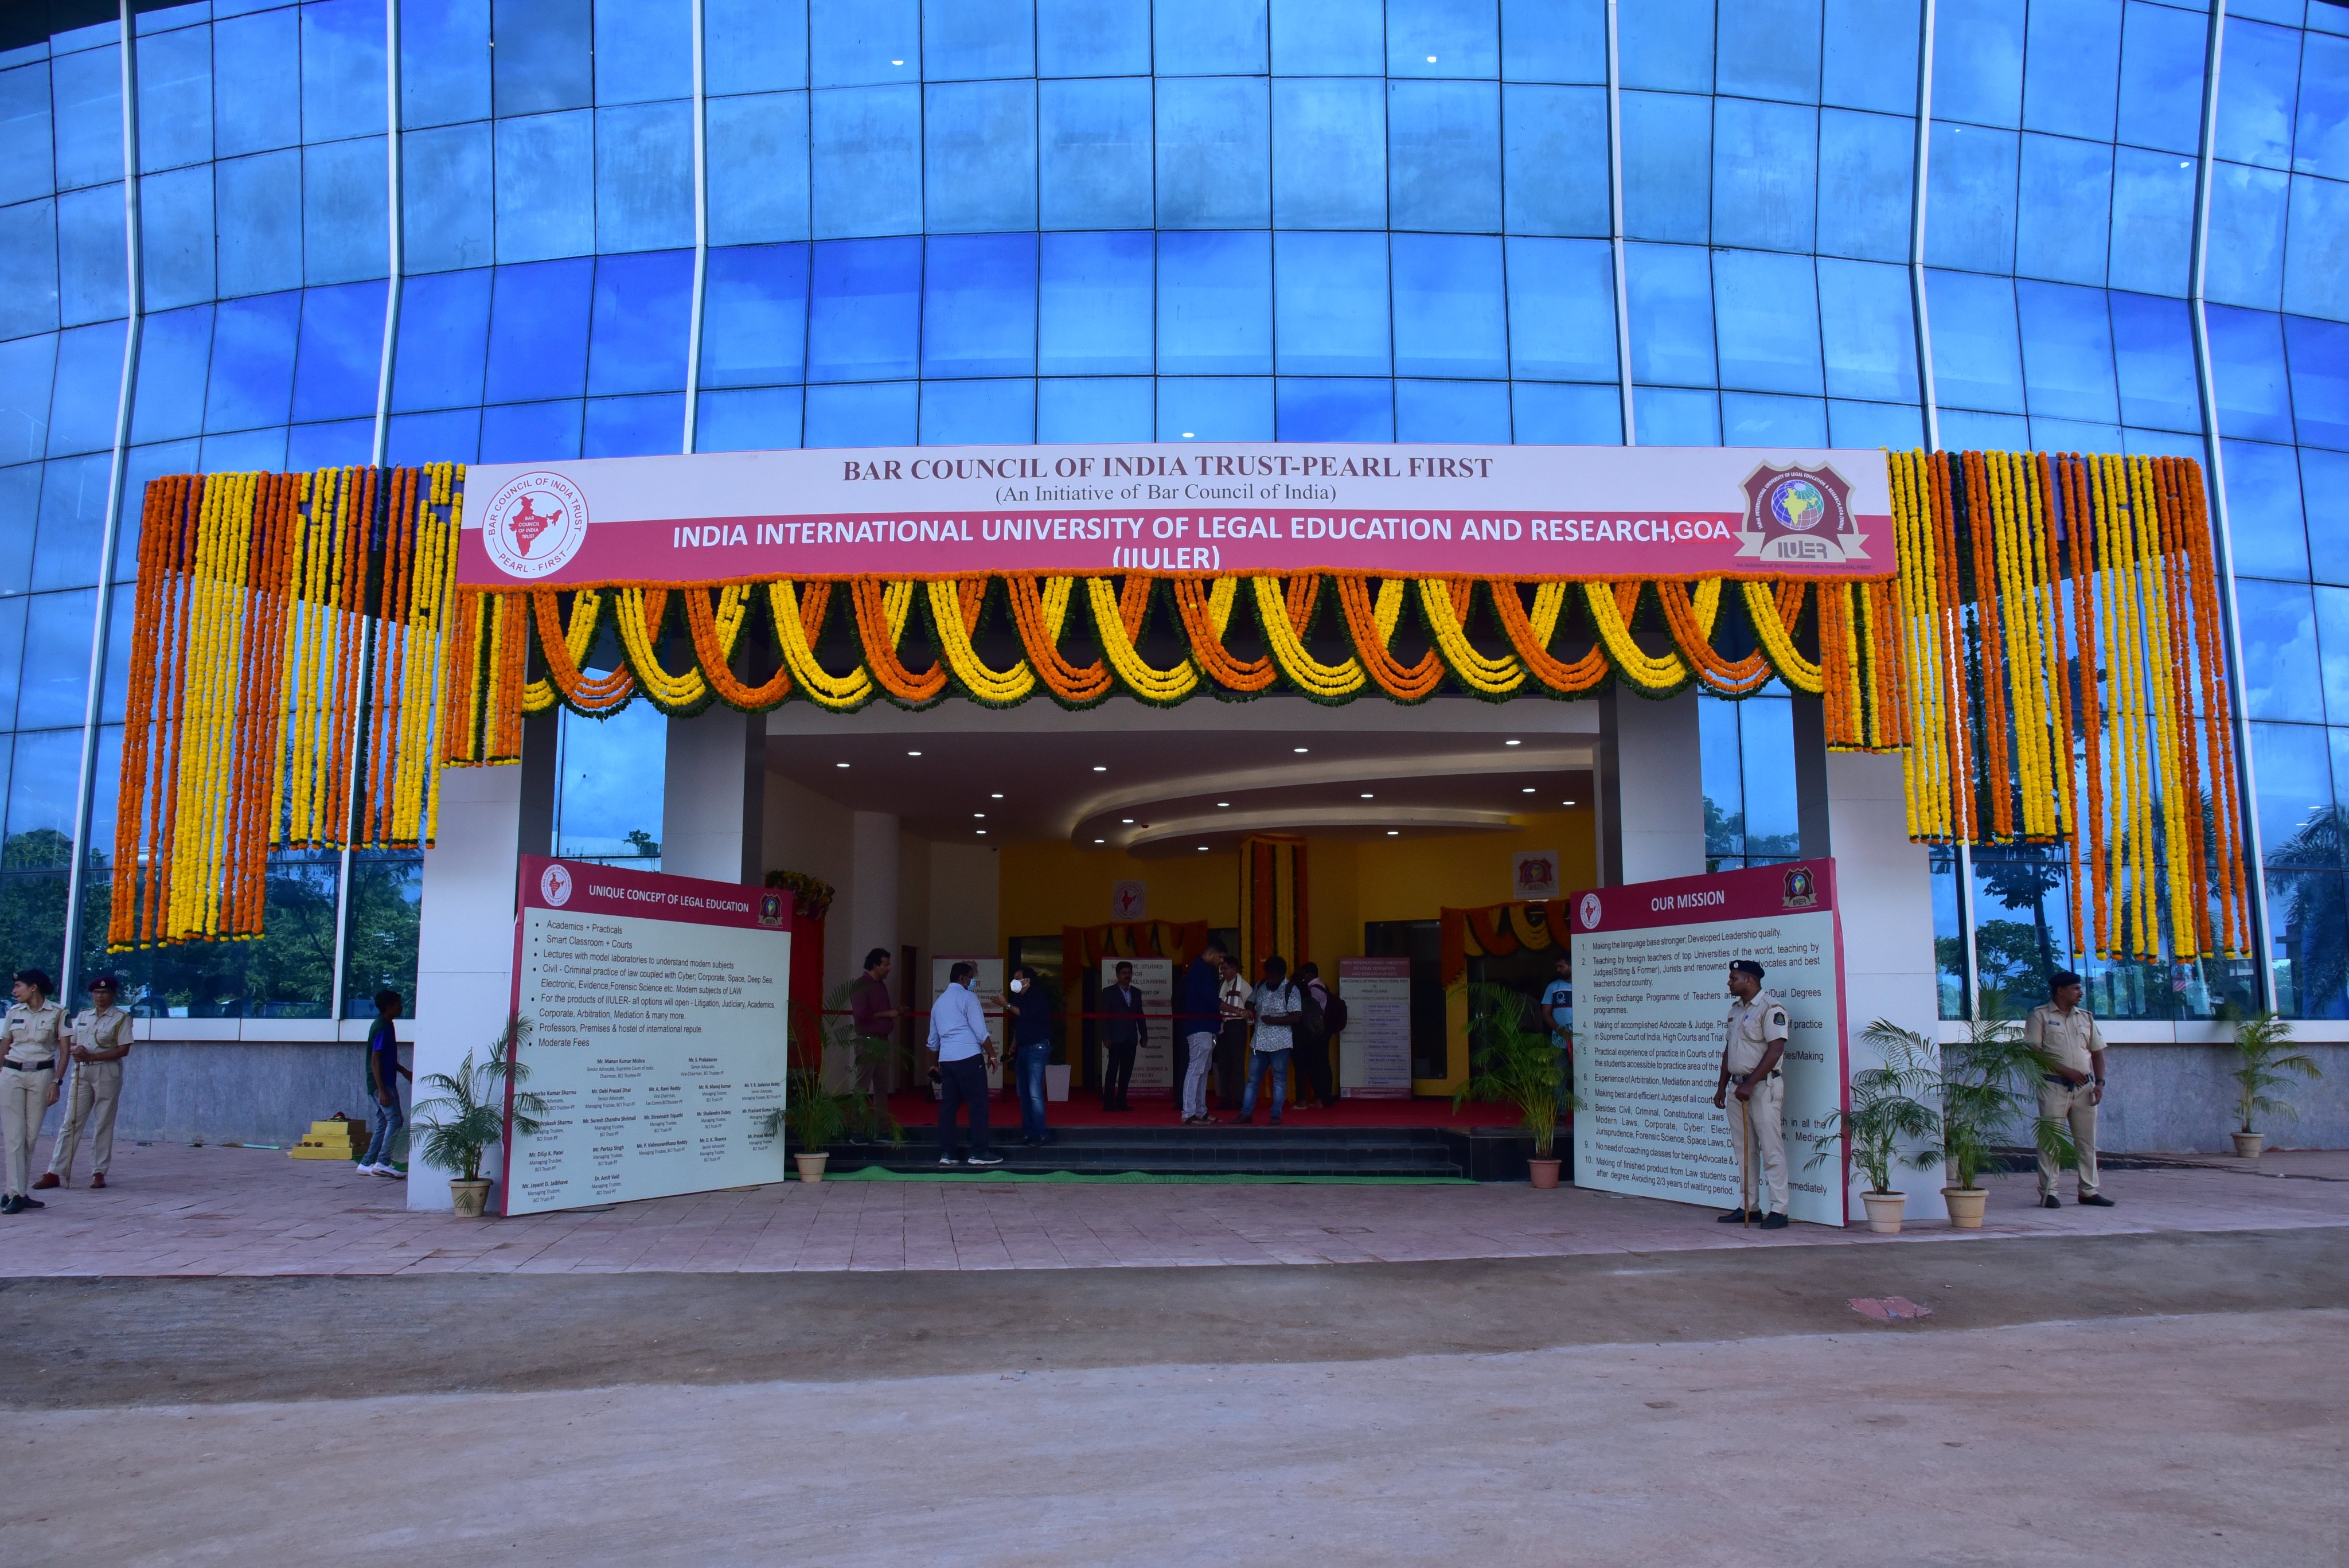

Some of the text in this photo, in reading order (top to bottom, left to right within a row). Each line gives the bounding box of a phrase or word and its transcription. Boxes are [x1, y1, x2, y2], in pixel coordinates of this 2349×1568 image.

[844, 455, 1493, 481] BAR COUNCIL OF INDIA TRUST-PEARL FIRST
[996, 483, 1336, 503] (An Initiative of Bar Council of India)
[1755, 487, 1766, 516] INTERNATIONAL
[1765, 474, 1784, 489] UNIVERSITY
[1804, 473, 1826, 486] EDUCATION
[489, 514, 498, 536] BAR
[494, 479, 532, 512] COUNCIL
[551, 479, 573, 500] INDIA
[571, 498, 583, 532] TRUST
[673, 525, 748, 548] INDIA
[756, 520, 973, 545] INTERNATIONAL
[982, 517, 1144, 540] UNIVERSITY
[1152, 517, 1188, 539] OF
[1199, 517, 1282, 538] LEGAL
[1291, 517, 1451, 540] EDUCATION
[1461, 518, 1522, 540] AND
[498, 553, 529, 572] PEARL
[538, 551, 568, 571] FIRST
[1113, 546, 1219, 570] (IIULER)
[589, 884, 748, 912] UNIQUE CONCEPT OF LEGAL EDUCATION
[1651, 890, 1724, 911] OUR MISSION
[547, 919, 584, 931] Academics
[592, 923, 623, 934] Practicals
[547, 934, 567, 944] Smart
[569, 936, 604, 947] Classroom
[612, 939, 632, 949] Courts
[1593, 942, 1611, 950] Making
[1611, 941, 1620, 949] the
[1621, 940, 1645, 949] language
[1646, 938, 1660, 946] base
[1661, 937, 1687, 946] stronger;
[1687, 933, 1720, 943] Developed
[1721, 930, 1757, 941] Leadership
[1758, 927, 1781, 939] quality.
[543, 949, 573, 959] Lectures
[575, 951, 588, 959] with
[590, 953, 610, 961] model
[611, 953, 647, 964] laboratories
[656, 957, 688, 966] understand
[690, 959, 711, 968] modern
[712, 961, 734, 970] subjects
[1593, 957, 1616, 965] Teaching
[1618, 955, 1624, 965] by
[1626, 955, 1645, 964] foreign
[1647, 953, 1672, 962] teachers
[1674, 951, 1680, 960] of
[1682, 952, 1692, 961] top
[1694, 949, 1730, 959] Universities
[1732, 947, 1739, 956] of
[1741, 947, 1751, 956] the
[1754, 945, 1774, 955] world,
[1777, 943, 1808, 954] teaching
[1810, 942, 1819, 953] by
[541, 978, 576, 989] Electronic,
[579, 980, 637, 990] Evidence,Forensic
[638, 982, 662, 992] Science
[676, 985, 697, 993] Modern
[699, 986, 721, 995] subjects
[723, 986, 728, 994] of
[729, 987, 742, 995] LAW
[1593, 980, 1616, 988] teachers
[1616, 978, 1622, 986] of
[1632, 978, 1653, 987] country.
[539, 1023, 703, 1034] Professors, Premises & hostel of international repute.
[539, 1037, 590, 1047] Moderate Fees
[1596, 1168, 1734, 1195] after degree. Avoiding 2/3 years of waiting period.
